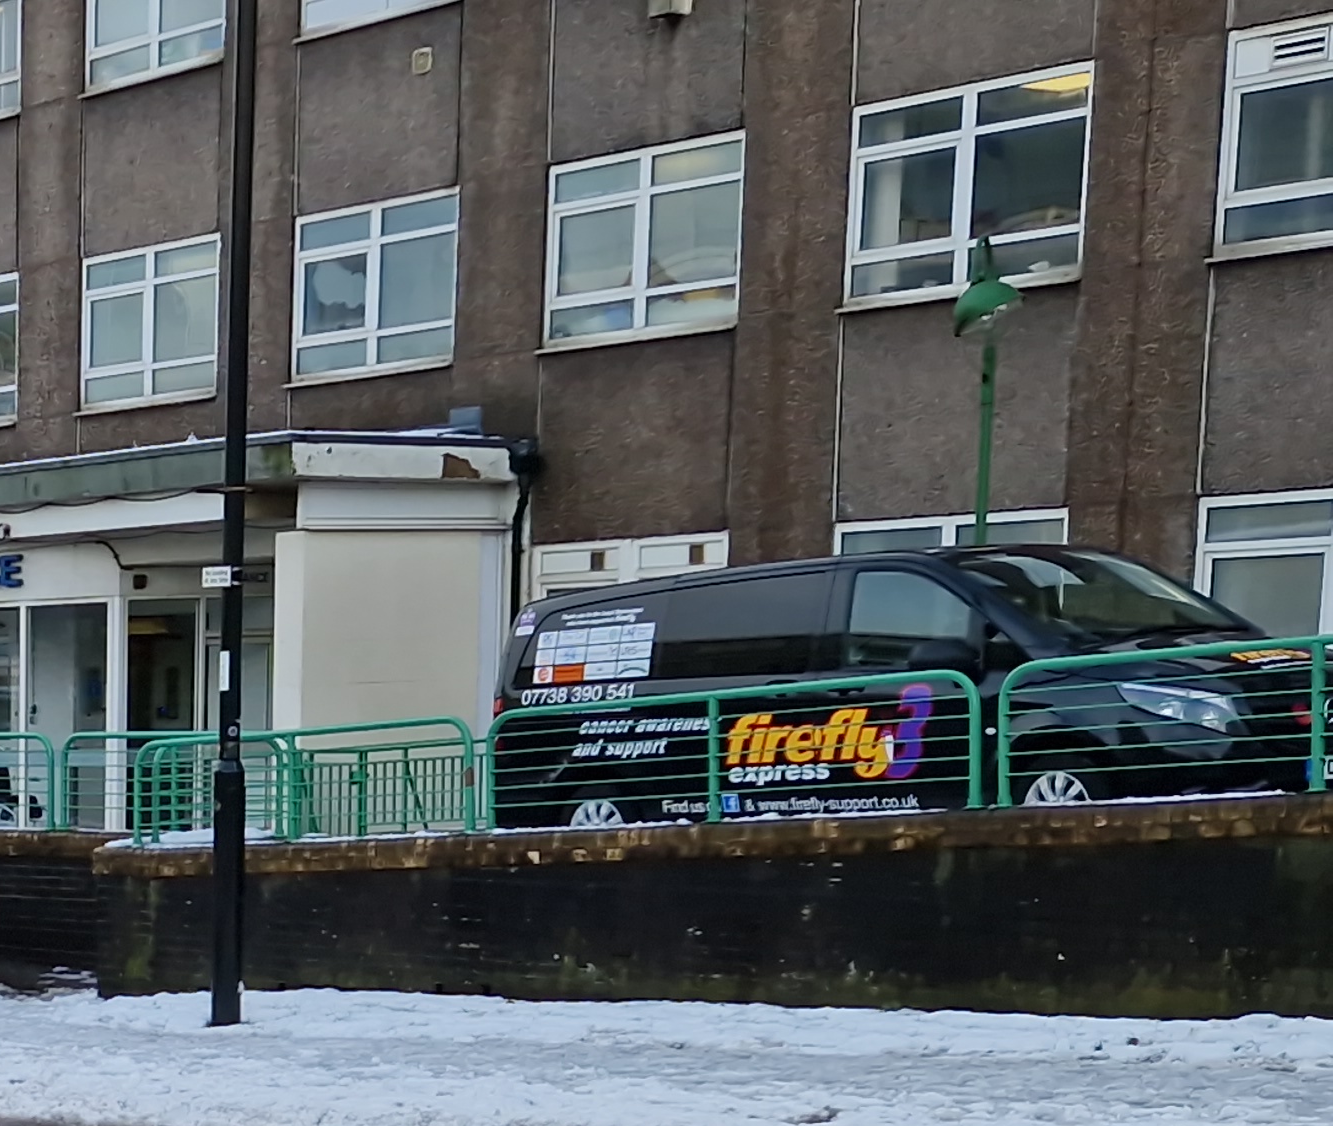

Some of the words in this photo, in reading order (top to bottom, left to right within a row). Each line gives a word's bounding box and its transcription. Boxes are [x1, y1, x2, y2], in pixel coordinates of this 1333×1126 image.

[521, 686, 568, 706] 07738
[571, 685, 603, 703] 390
[606, 683, 634, 699] 541
[578, 719, 633, 735] cancer
[635, 717, 722, 733] awarenes
[572, 738, 604, 757] and
[605, 738, 668, 759] support
[725, 708, 893, 779] firefly
[728, 764, 831, 786] express
[661, 799, 689, 813] Find
[689, 801, 706, 813] us
[743, 799, 755, 811] &
[757, 794, 919, 812] www.firefly-support.co.uk
